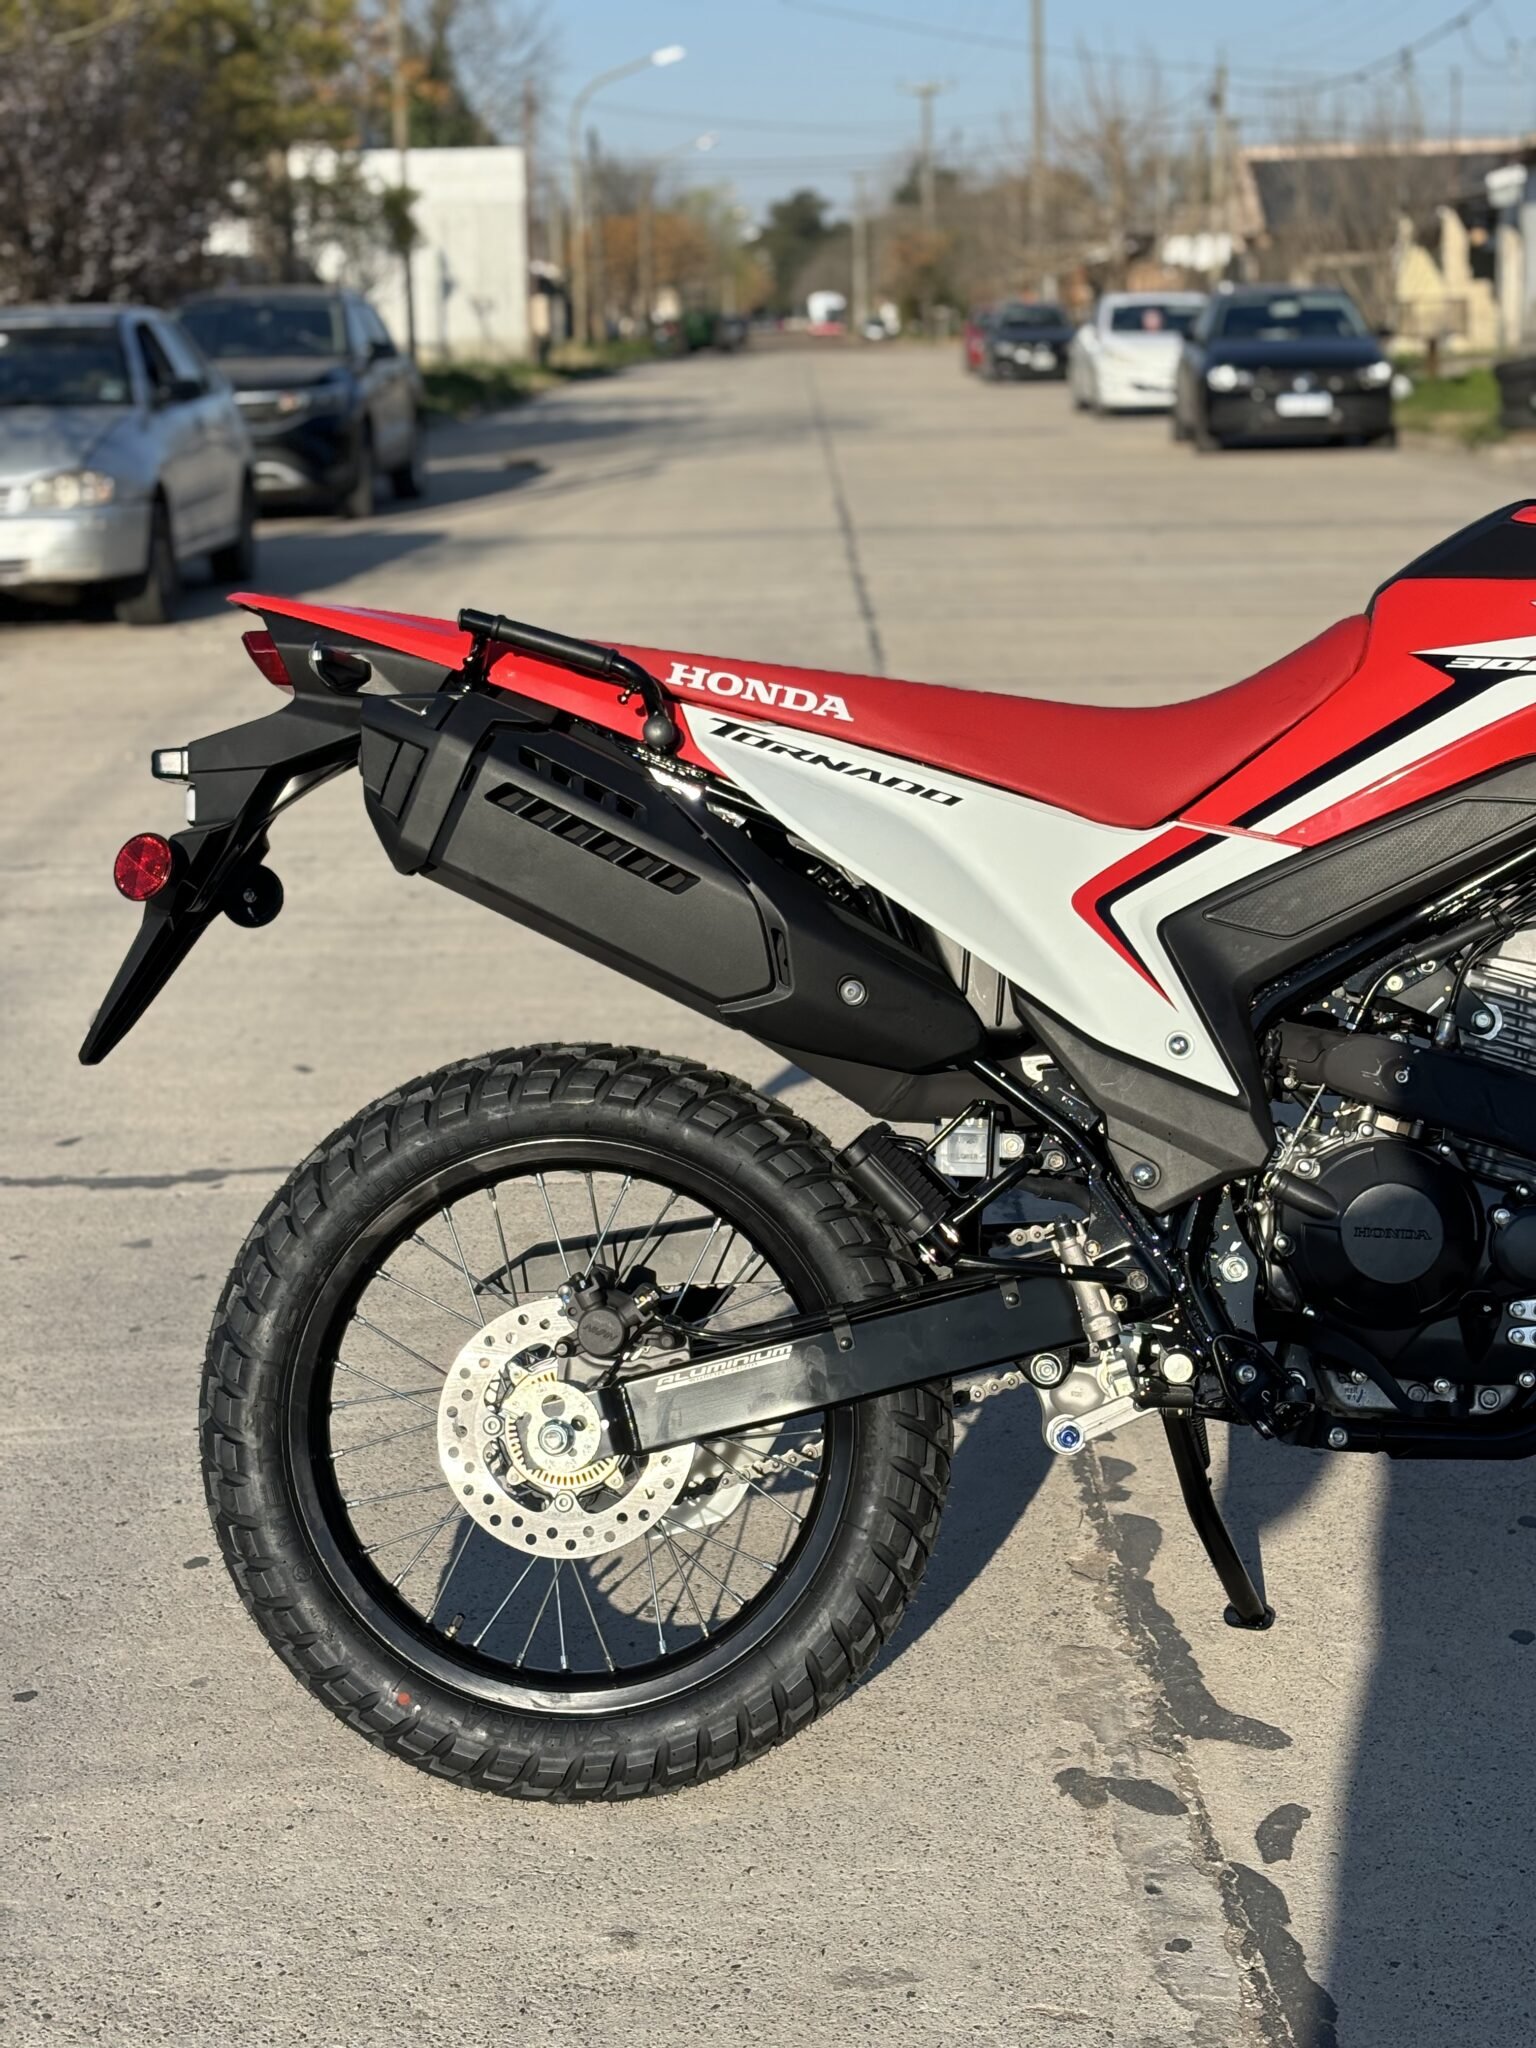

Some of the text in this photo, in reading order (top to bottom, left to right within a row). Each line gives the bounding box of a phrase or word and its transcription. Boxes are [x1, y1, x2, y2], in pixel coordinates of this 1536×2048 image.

[666, 662, 854, 722] HONDA
[709, 717, 963, 806] TORNADO
[334, 1135, 462, 1232] ENDURO
[1353, 1226, 1432, 1240] HONDA
[657, 1345, 792, 1386] ALUMINIUM
[462, 1704, 635, 1748] SAHARA
